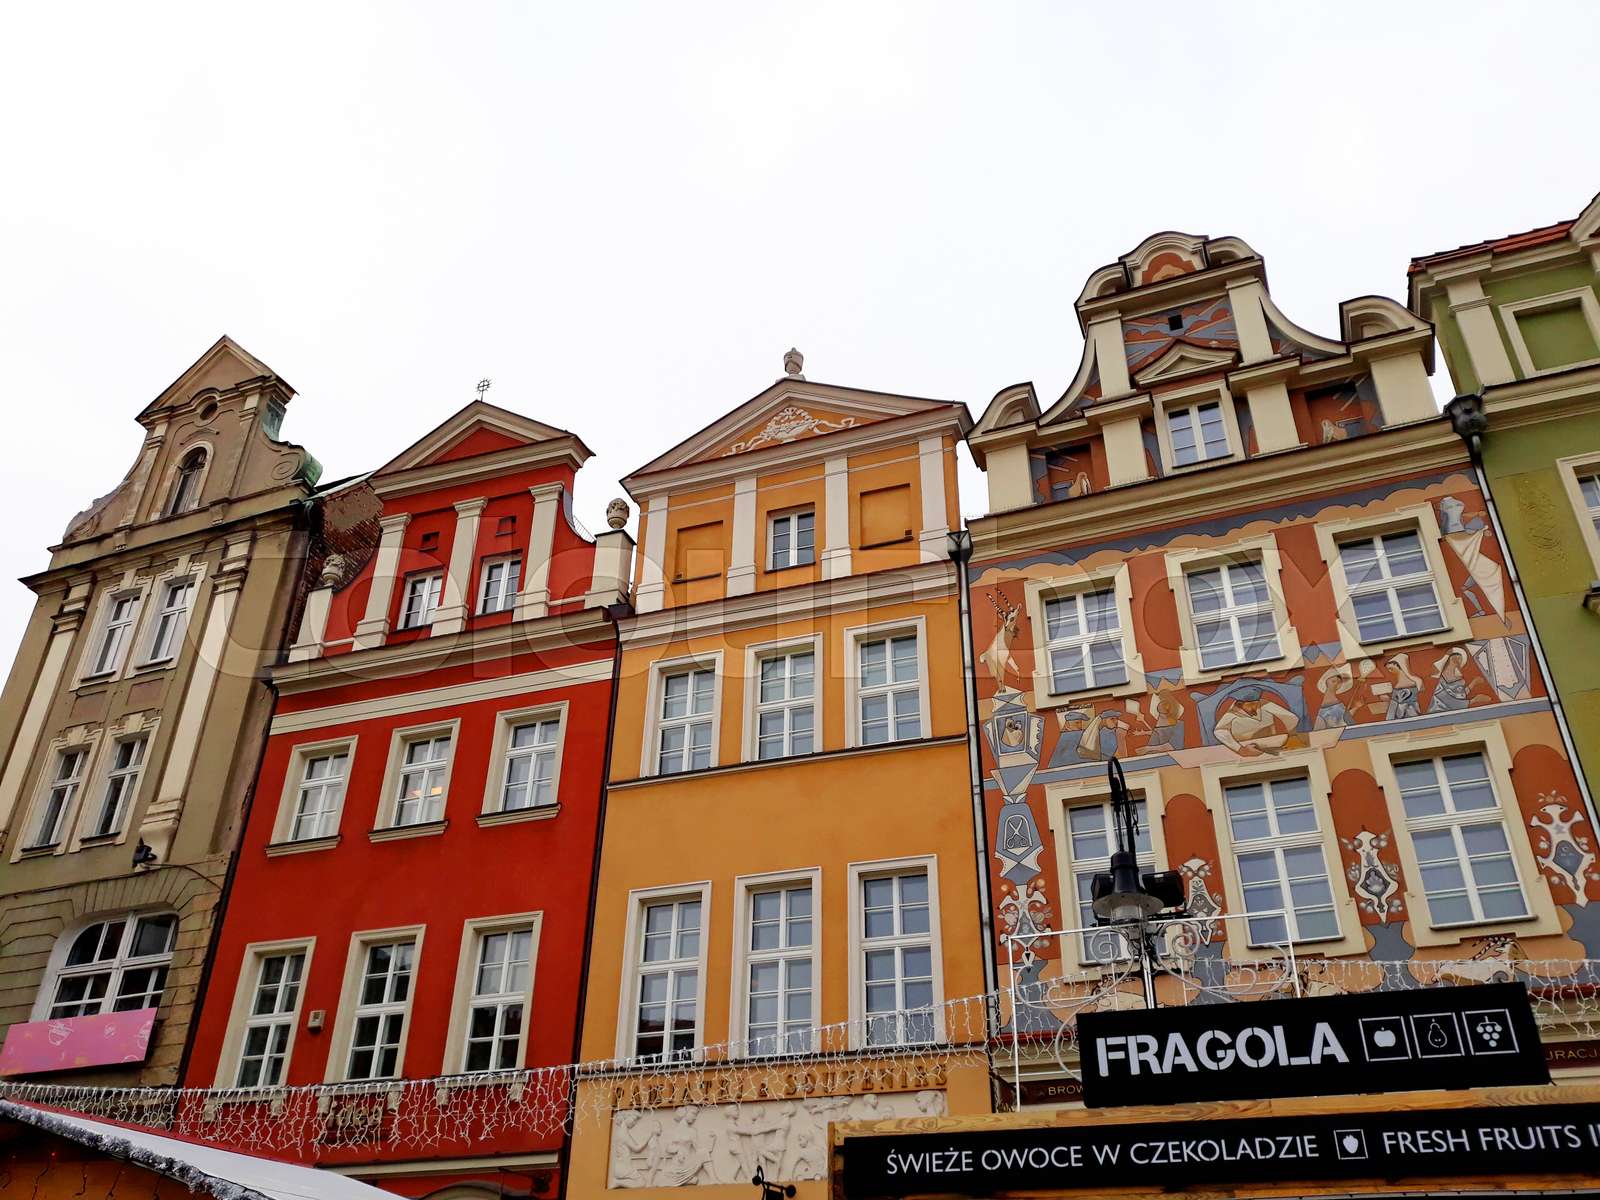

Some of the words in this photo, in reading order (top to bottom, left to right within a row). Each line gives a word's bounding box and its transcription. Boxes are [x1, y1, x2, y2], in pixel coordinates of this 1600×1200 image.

[1096, 1022, 1350, 1077] FRAGOLA
[887, 1147, 974, 1175] ŚWIEŻE
[981, 1145, 1083, 1170] OWOCE
[1092, 1144, 1121, 1166] W
[1130, 1135, 1320, 1165] CZEKOLADZIE
[1382, 1128, 1471, 1154] FRESH
[1478, 1125, 1582, 1151] FRUITS
